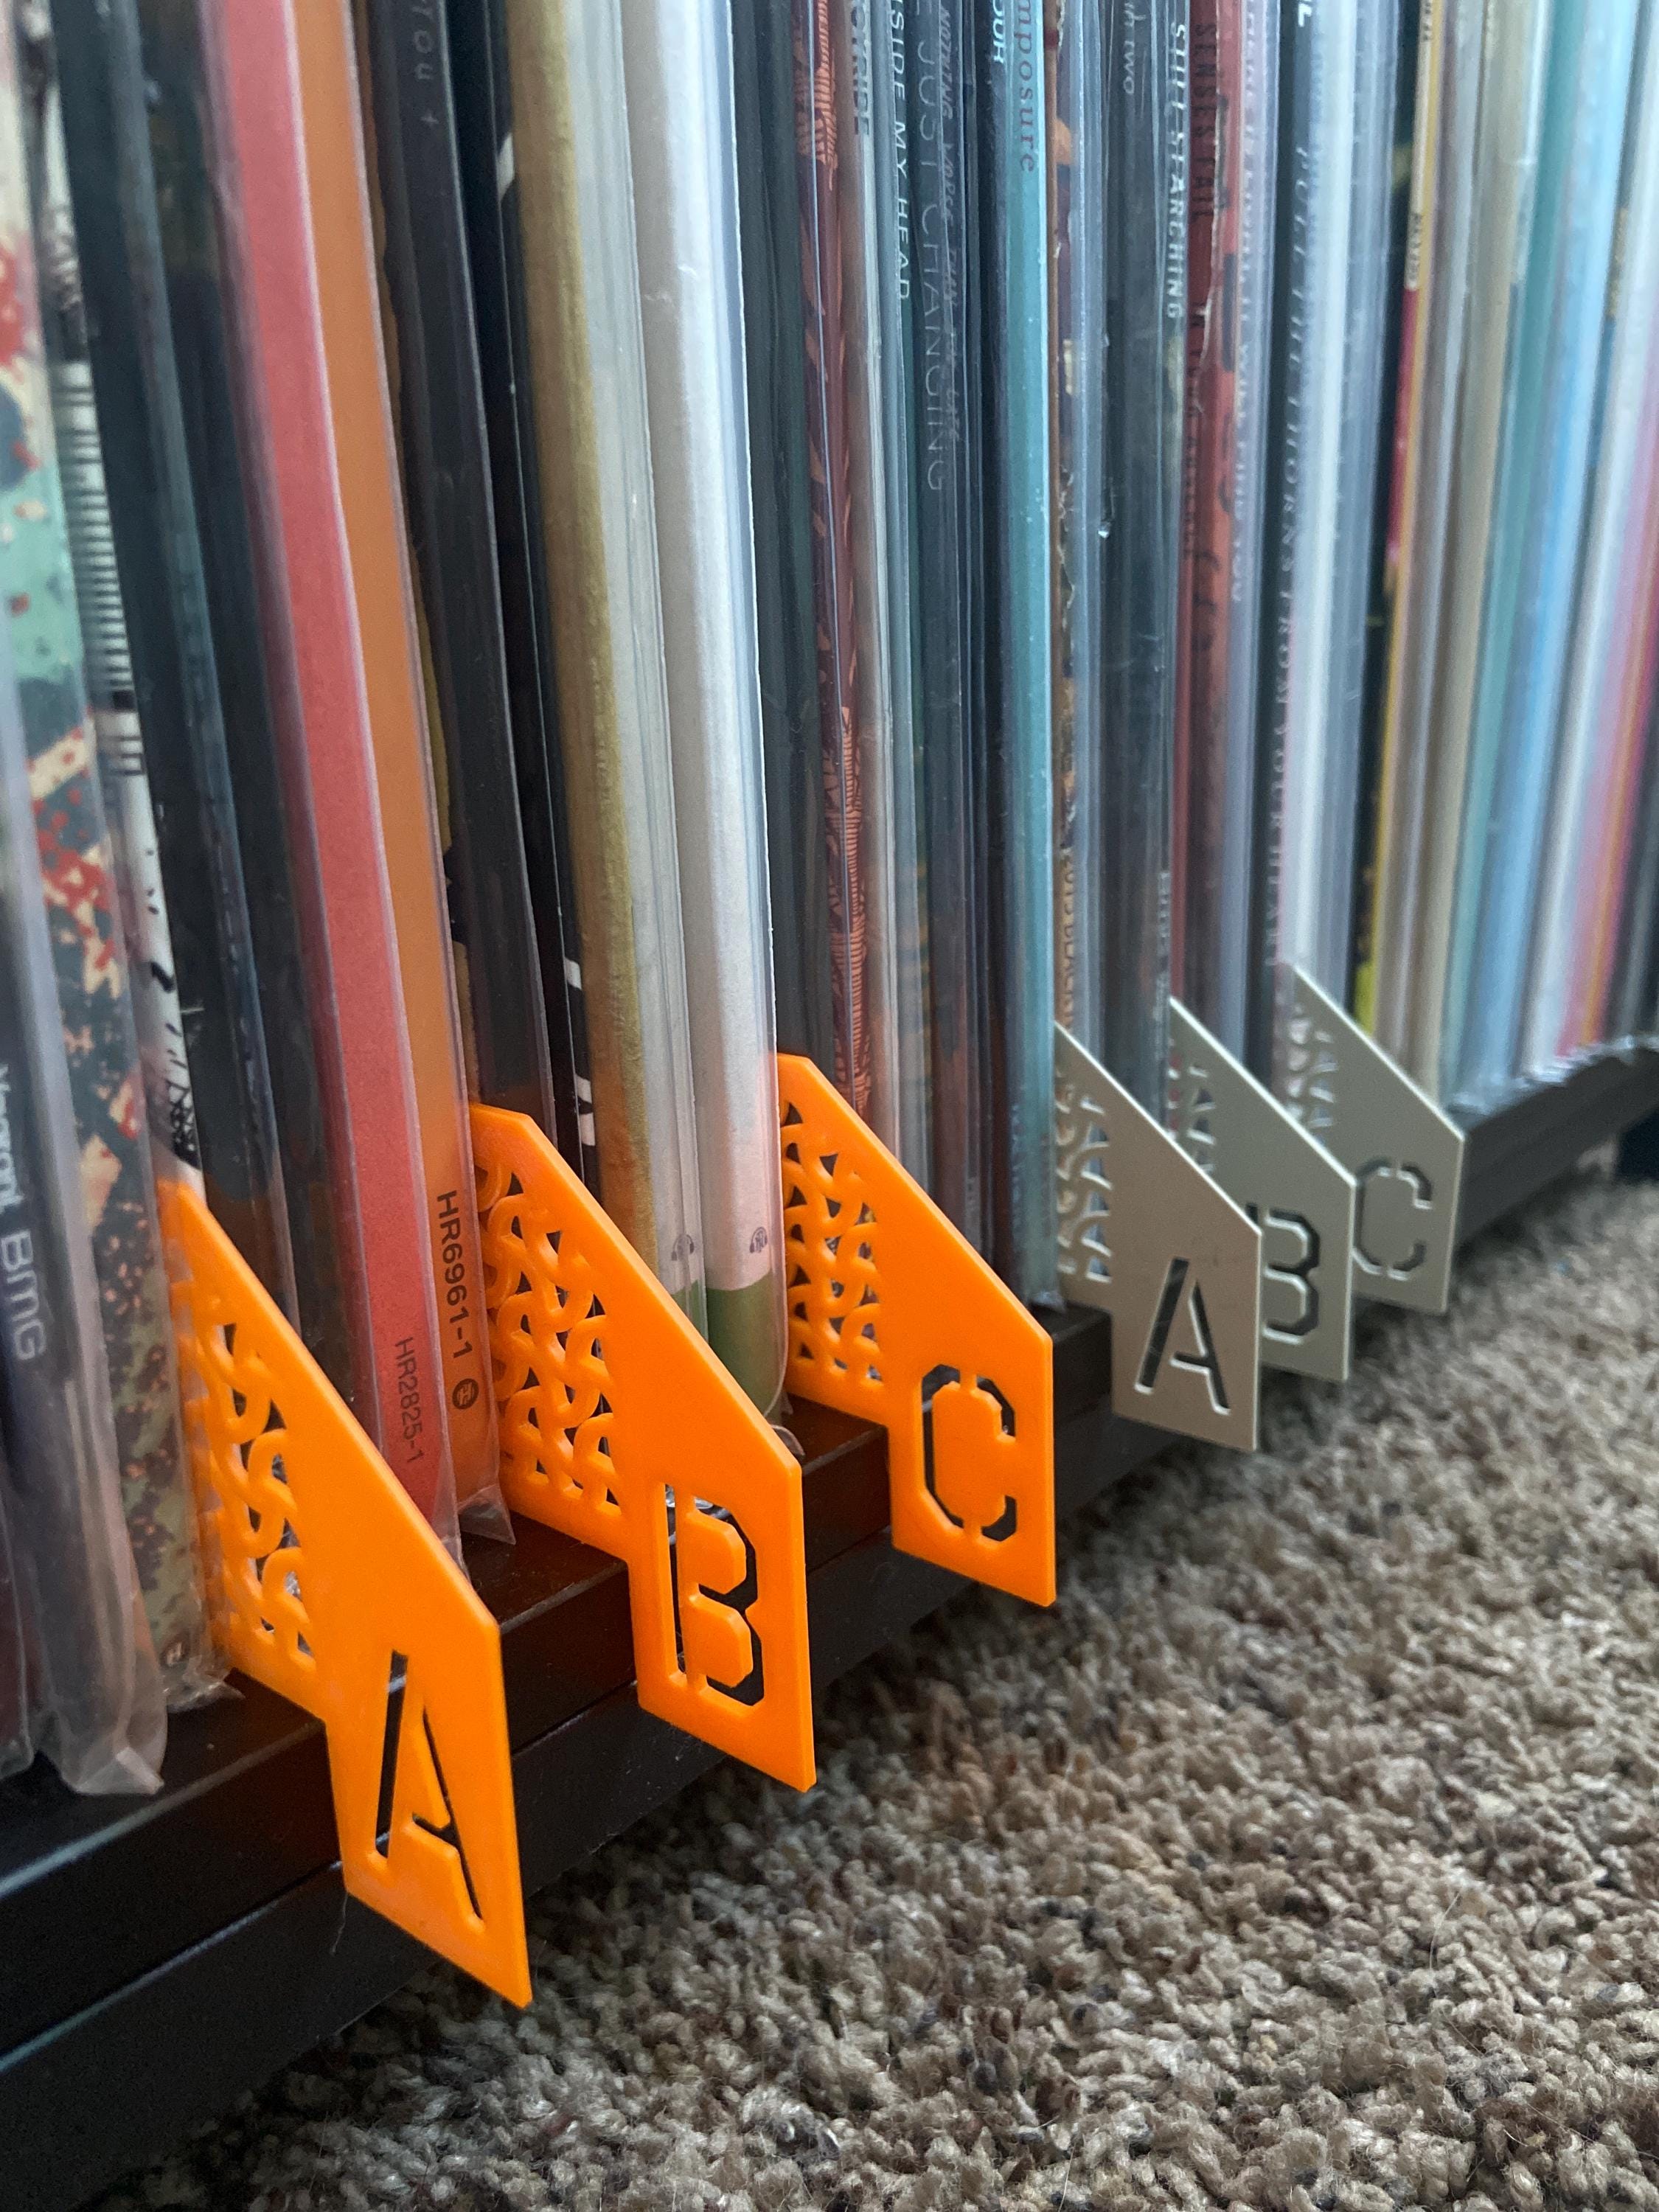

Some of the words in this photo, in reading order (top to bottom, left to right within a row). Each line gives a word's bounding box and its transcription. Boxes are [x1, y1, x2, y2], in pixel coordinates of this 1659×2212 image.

[888, 0, 906, 100] SIDE
[897, 198, 910, 300] HEAD
[1166, 130, 1186, 319] SEARCHING
[437, 1189, 474, 1359] HR6961-1
[1245, 1202, 1321, 1345] B
[1353, 1156, 1433, 1281] C
[394, 1337, 425, 1464] HR2825-1
[1134, 1256, 1231, 1416] A
[921, 1363, 1018, 1545] C
[663, 1483, 765, 1709] B
[370, 1648, 487, 1932] A
